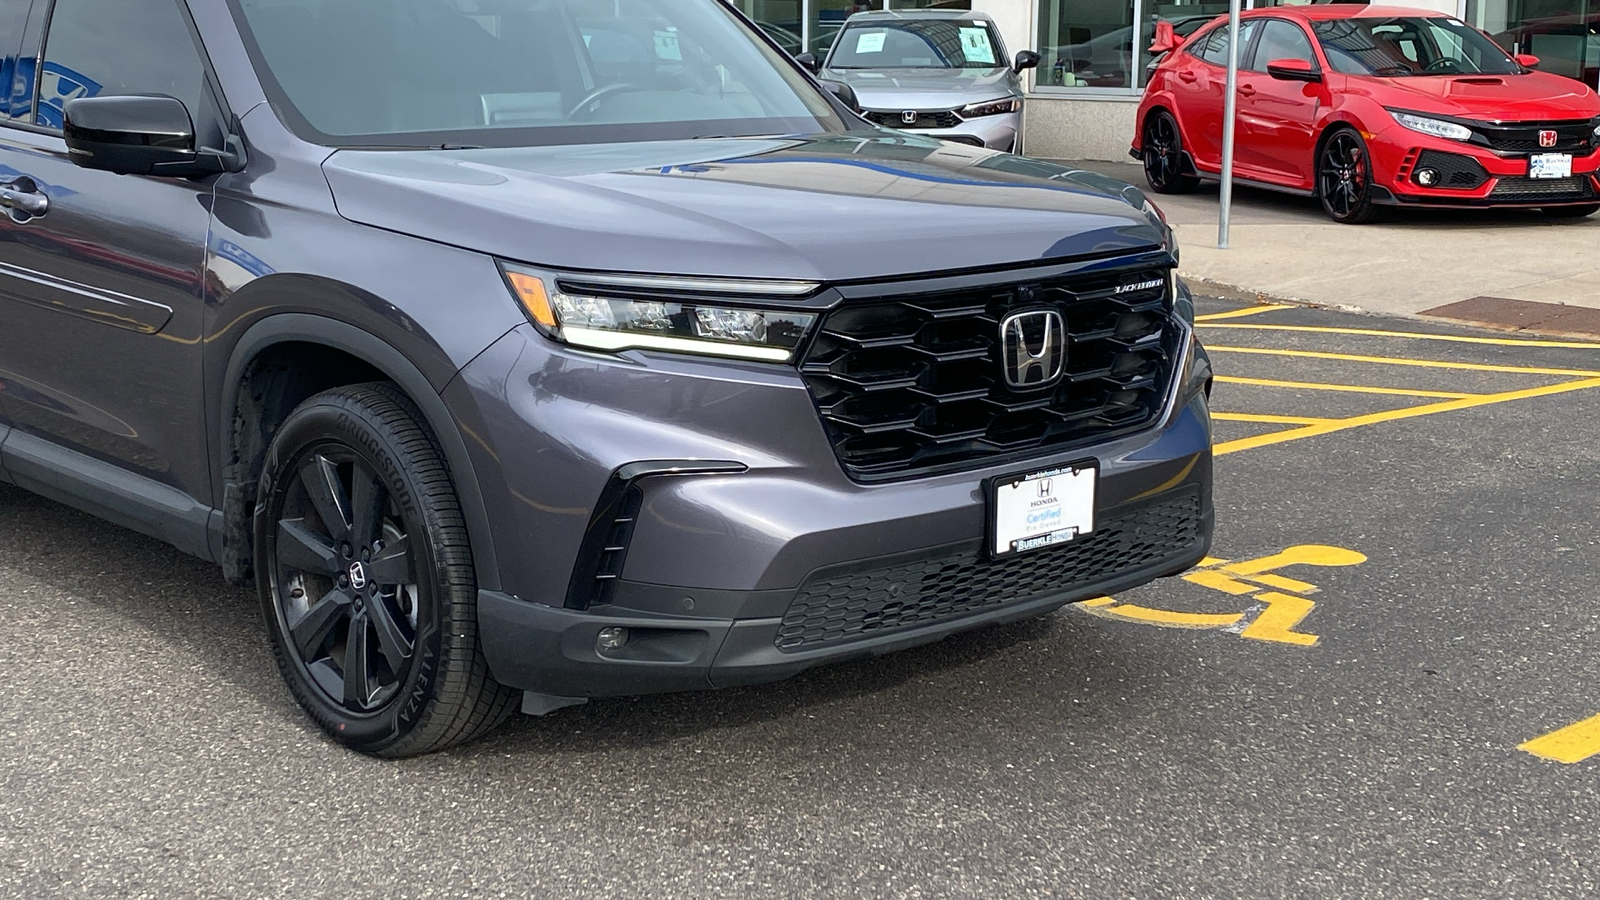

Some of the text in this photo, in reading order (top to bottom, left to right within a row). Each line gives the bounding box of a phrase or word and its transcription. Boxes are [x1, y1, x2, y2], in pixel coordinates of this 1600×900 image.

[338, 413, 418, 519] BRIDGESTONE
[1027, 507, 1061, 523] Certified
[1030, 497, 1059, 507] HONDA
[400, 644, 434, 722] ALENZA
